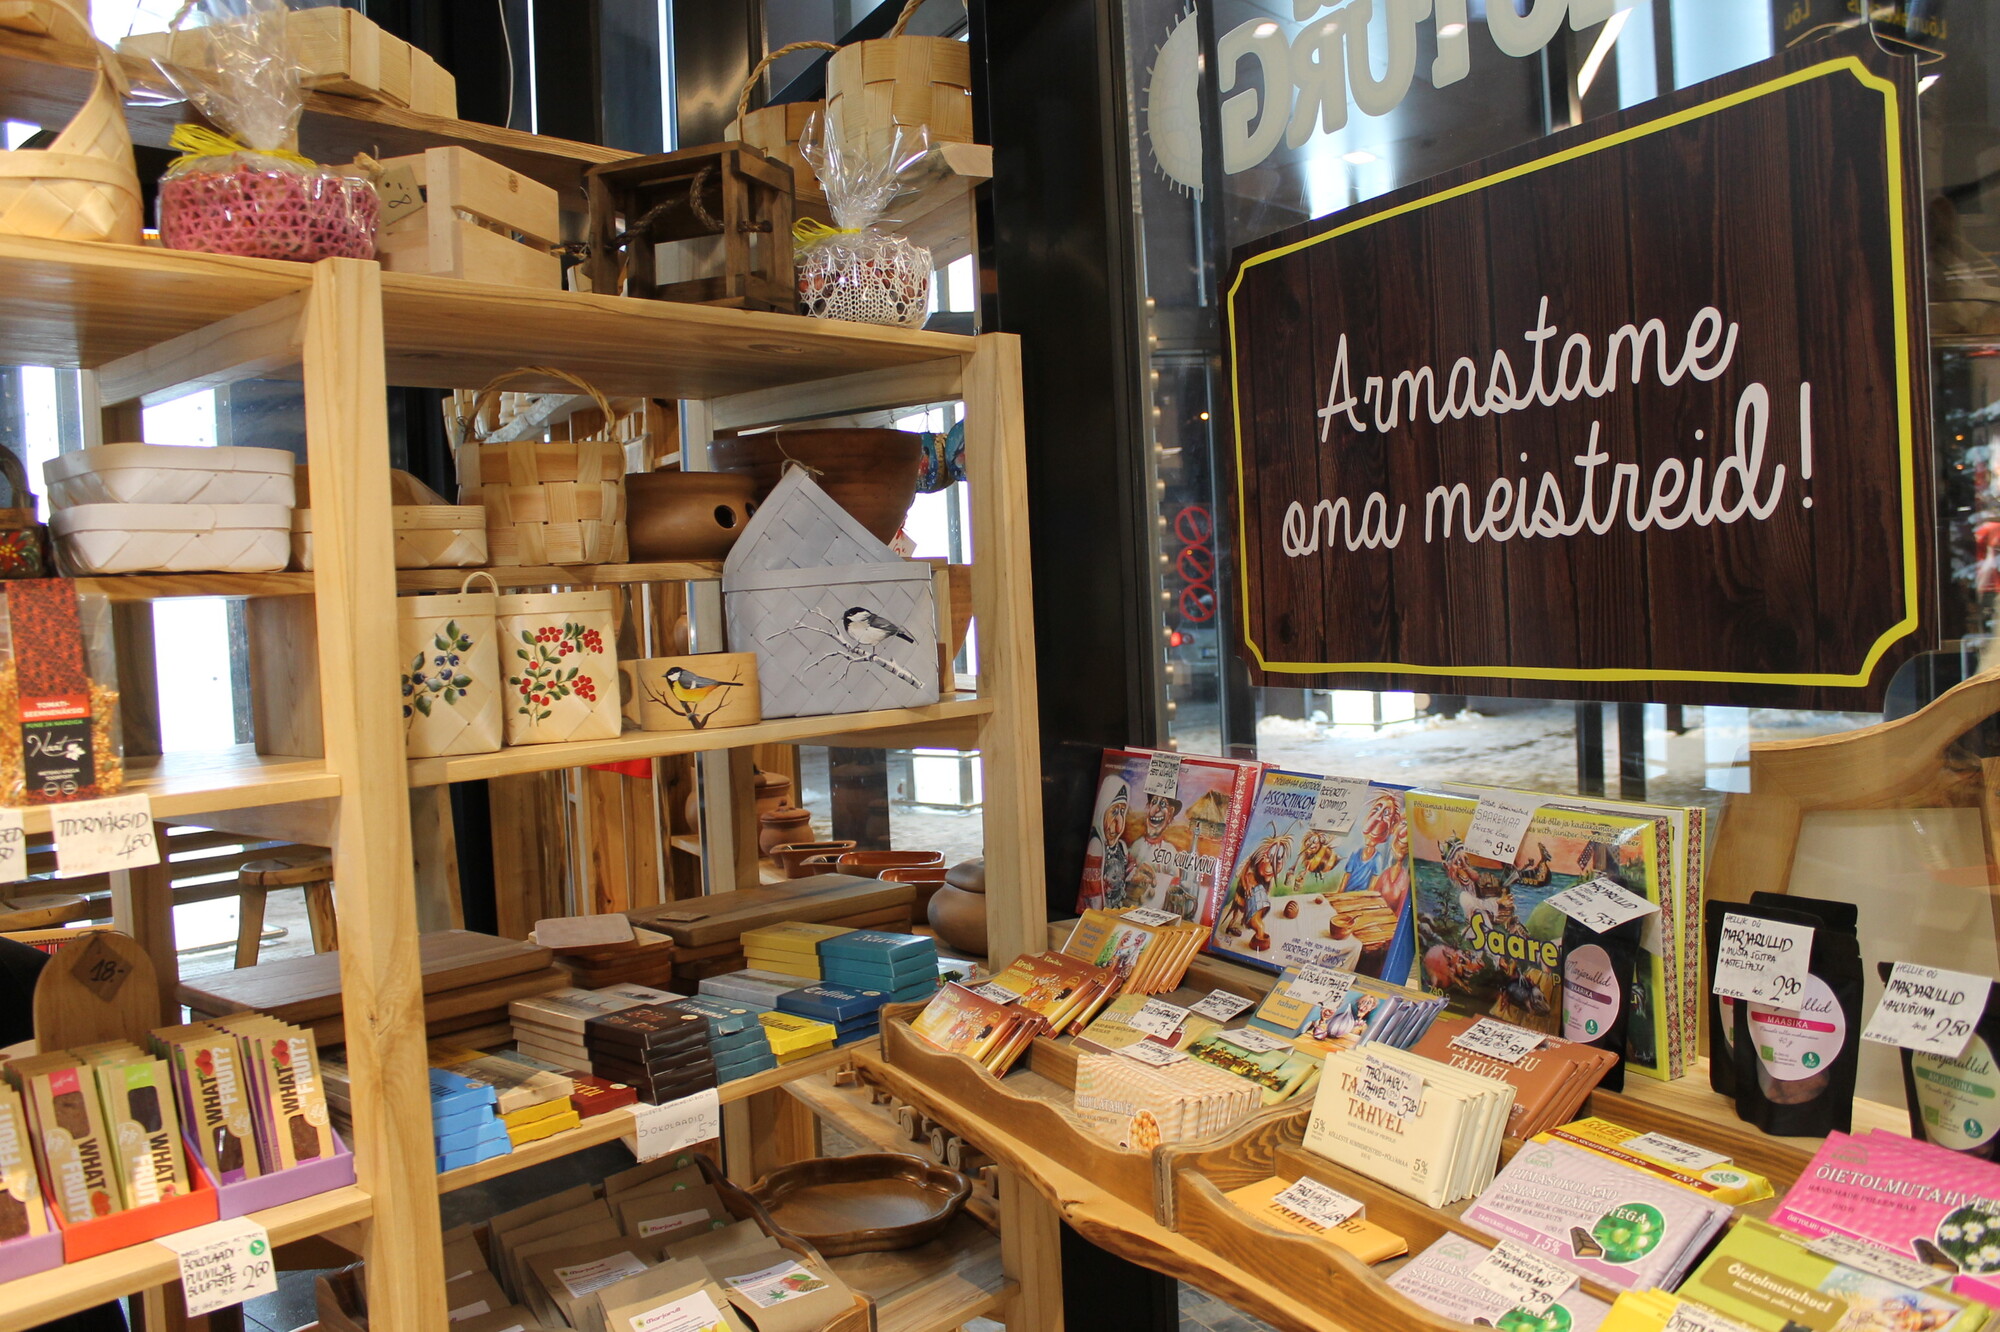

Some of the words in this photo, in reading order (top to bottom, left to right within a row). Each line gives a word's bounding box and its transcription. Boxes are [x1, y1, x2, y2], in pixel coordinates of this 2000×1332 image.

[1317, 295, 1738, 443] Armastame
[1282, 497, 1407, 557] oma
[1425, 382, 1814, 540] meistreid!
[1475, 808, 1521, 828] SAAREMAA
[1470, 911, 1560, 969] Saare
[1722, 927, 1794, 953] MARJARULLID
[1888, 979, 1965, 1006] MARJARULLID
[1767, 1016, 1810, 1029] MAASIKA
[212, 1047, 239, 1105] FRUIT?
[276, 1066, 300, 1115] WHAT
[288, 1037, 315, 1096] FRUIT?
[1450, 1053, 1511, 1083] TAHVEL
[200, 1077, 224, 1126] WHAT
[1313, 1118, 1326, 1133] 5%
[1348, 1097, 1404, 1136] TAHVEL
[79, 1137, 106, 1190] WHAT
[150, 1132, 176, 1184] WHAT
[1413, 1158, 1429, 1175] 5%
[61, 1160, 94, 1223] FRUIT?
[1510, 1167, 1620, 1201] PIIMAŠOKOLAAD
[1728, 1263, 1833, 1313] Õietolmutahvel
